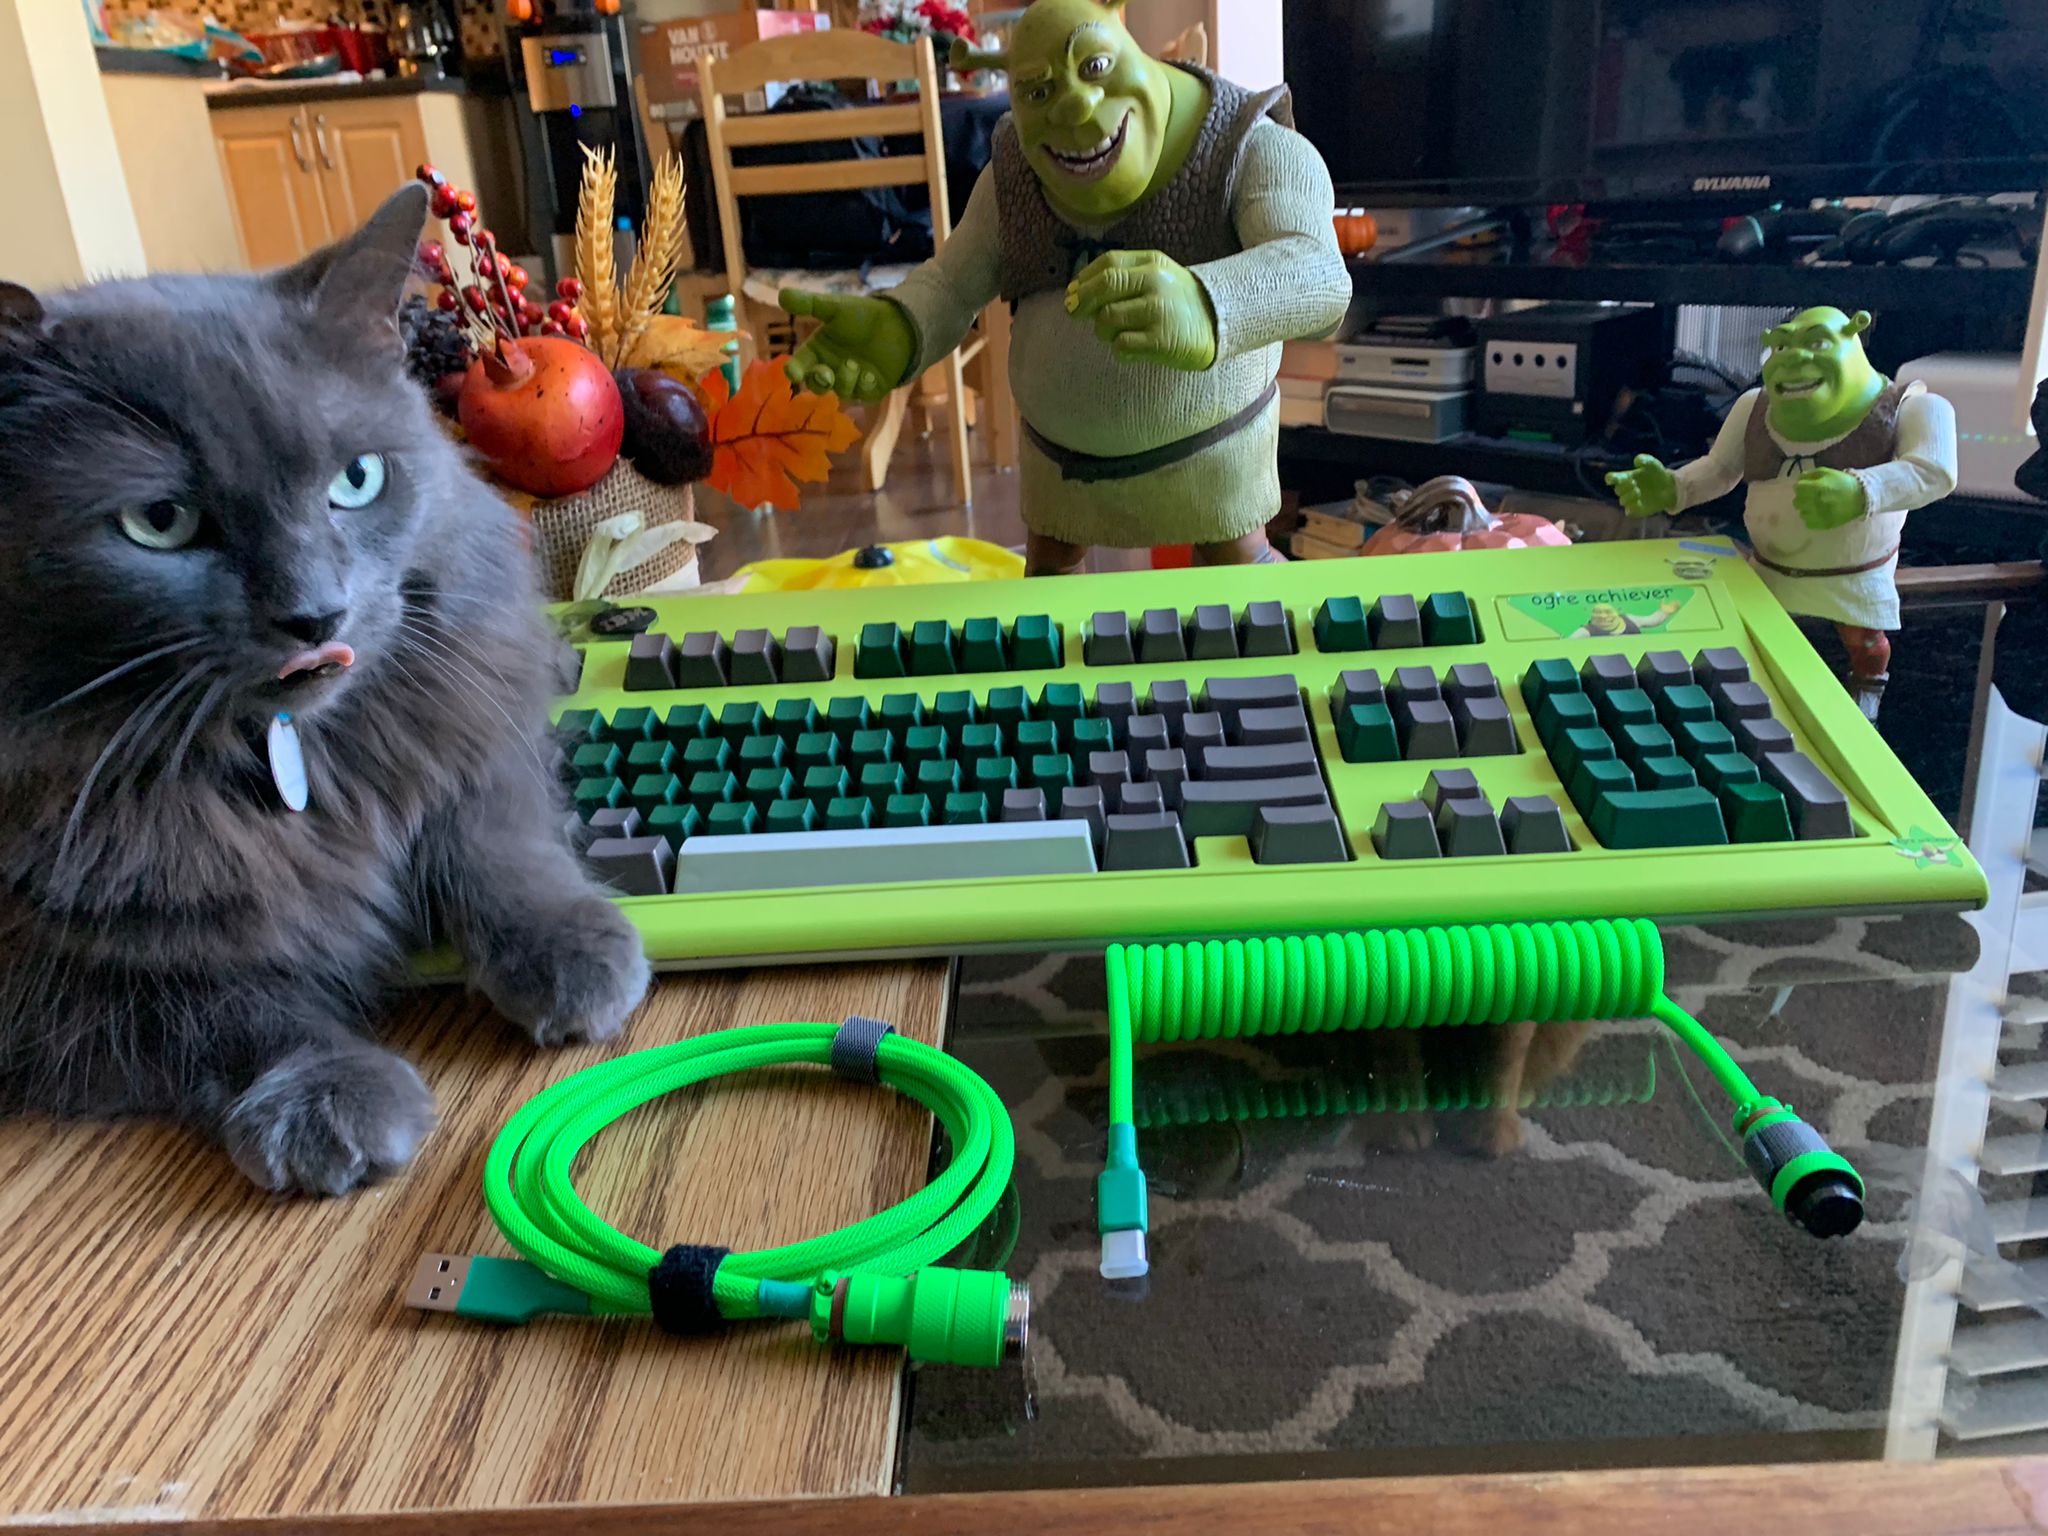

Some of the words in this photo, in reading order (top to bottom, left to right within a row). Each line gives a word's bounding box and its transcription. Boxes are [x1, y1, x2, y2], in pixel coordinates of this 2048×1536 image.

[667, 26, 699, 45] VAN
[1693, 175, 1771, 191] SYLVANIA
[1531, 593, 1578, 610] ogre
[1585, 586, 1674, 604] achiever
[599, 607, 649, 632] IBM
